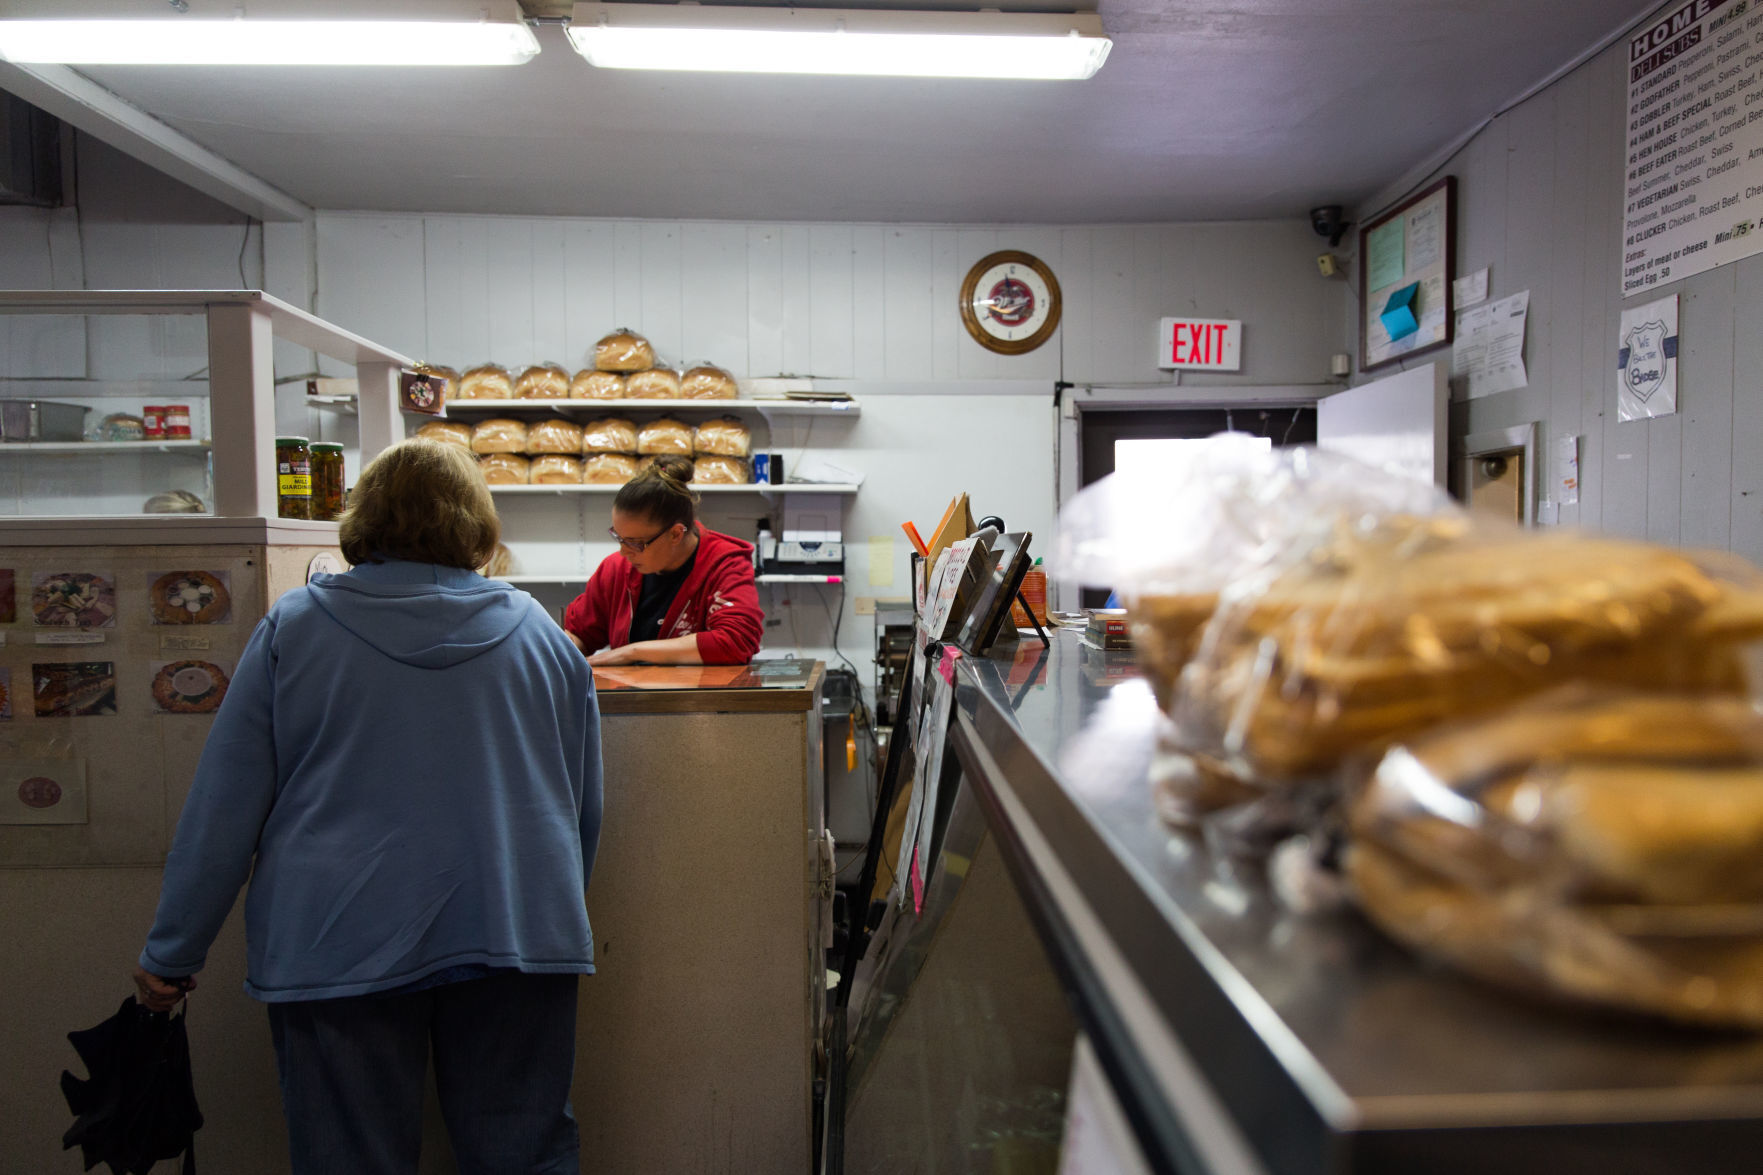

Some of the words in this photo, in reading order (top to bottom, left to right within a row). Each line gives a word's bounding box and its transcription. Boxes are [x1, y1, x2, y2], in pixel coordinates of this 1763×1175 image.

[1634, 0, 1711, 59] HOME
[1632, 52, 1661, 82] DELI
[1663, 28, 1699, 61] SUBS
[1640, 65, 1677, 93] STANDARD
[1640, 79, 1680, 110] GODFATHER
[1639, 127, 1655, 144] HAM
[1663, 113, 1680, 131] BEEF
[1681, 97, 1712, 121] SPECIAL
[1714, 84, 1736, 104] Roast
[1639, 102, 1671, 127] GOBBLER
[1638, 161, 1655, 177] BEEF
[1655, 150, 1677, 168] EATER
[1678, 140, 1699, 157] Roast
[1719, 115, 1747, 137] Corned
[1639, 146, 1653, 160] HEN
[1653, 132, 1678, 152] HOUSE
[1711, 142, 1734, 159] Swiss
[1637, 183, 1679, 210] VEGETARIAN
[1636, 222, 1667, 243] CLUCKER
[1699, 202, 1720, 217] Roast
[1624, 263, 1646, 278] Layers
[1655, 251, 1672, 267] meat
[1682, 240, 1708, 257] cheese
[1715, 229, 1733, 245] Mini
[1624, 276, 1644, 291] Sliced
[1645, 273, 1657, 285] Egg
[1172, 323, 1228, 364] EXIT
